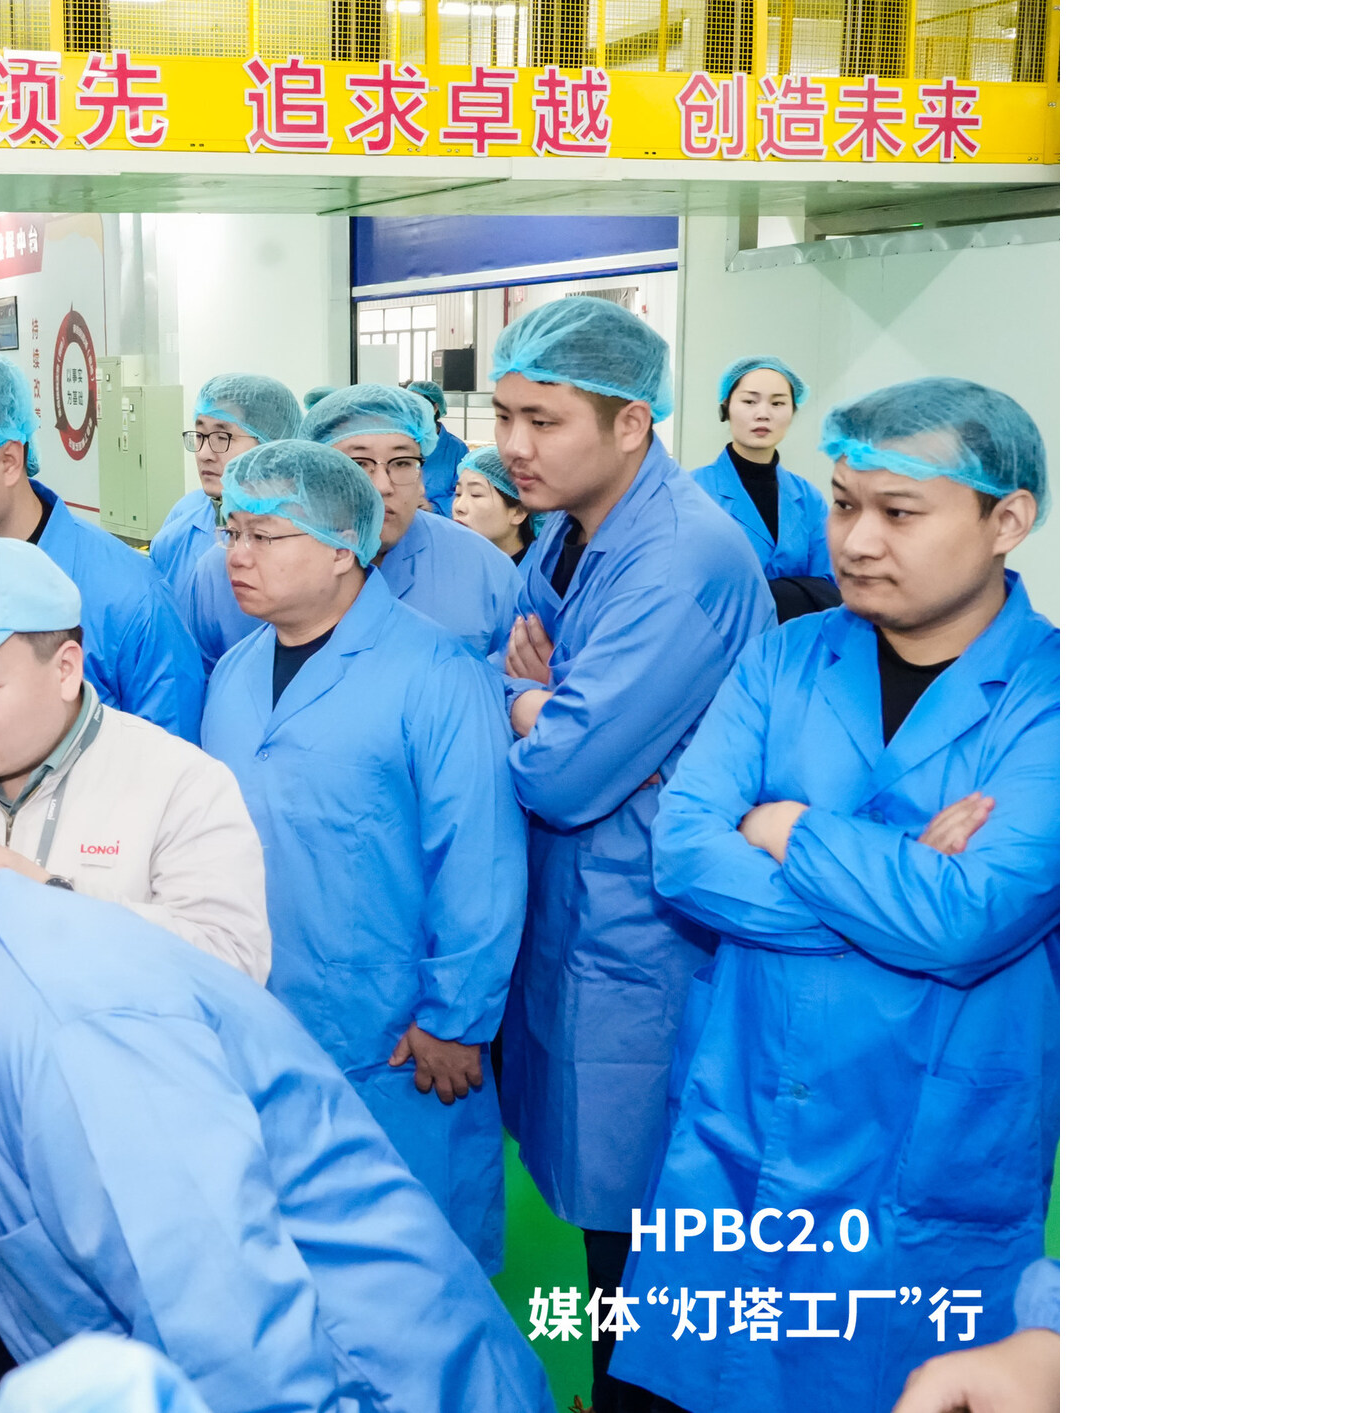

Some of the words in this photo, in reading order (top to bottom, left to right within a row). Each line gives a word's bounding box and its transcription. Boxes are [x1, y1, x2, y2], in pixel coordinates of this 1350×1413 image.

[245, 56, 612, 156] 追求卓越
[677, 74, 982, 161] 创造未来
